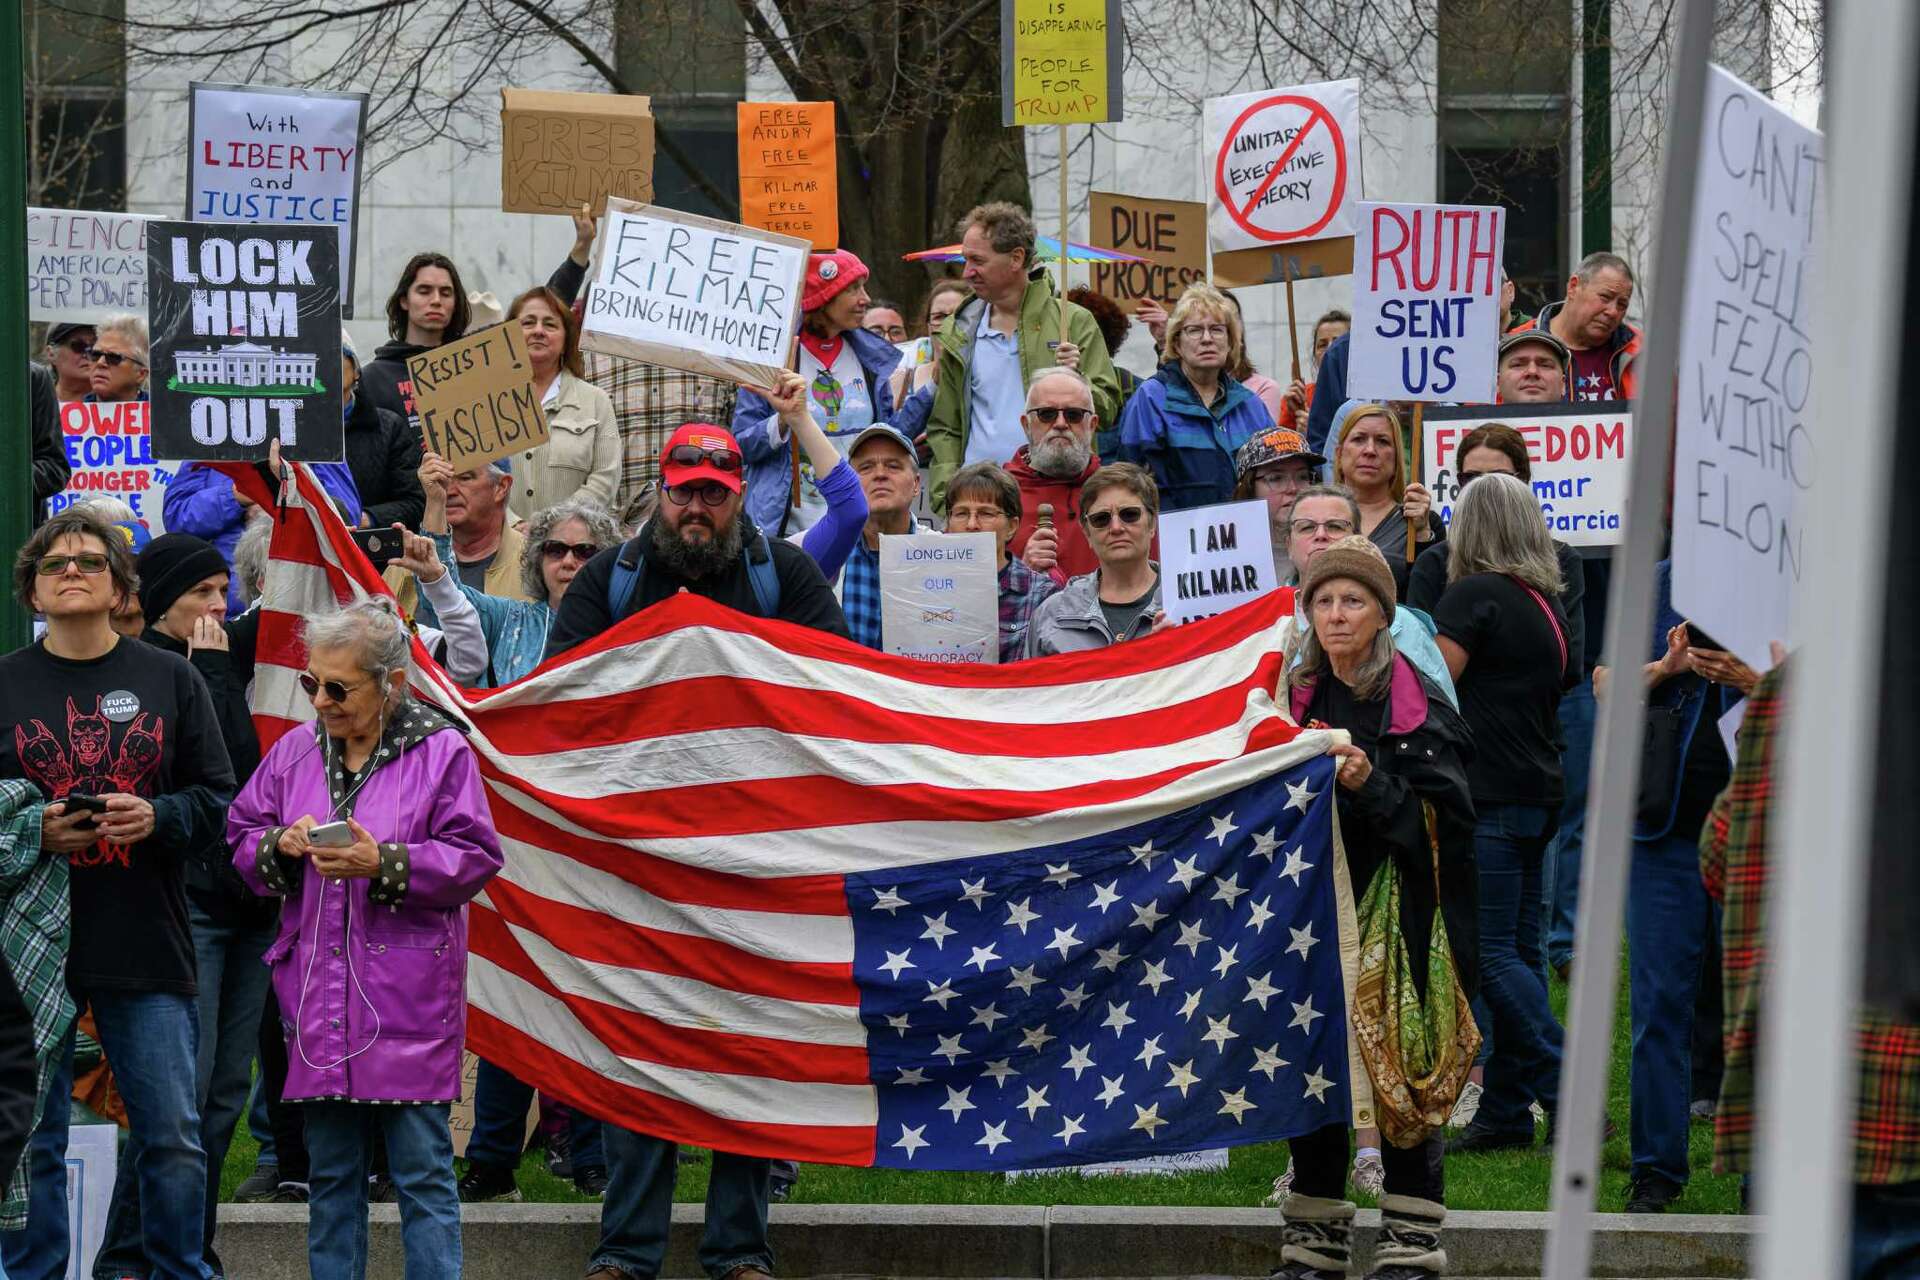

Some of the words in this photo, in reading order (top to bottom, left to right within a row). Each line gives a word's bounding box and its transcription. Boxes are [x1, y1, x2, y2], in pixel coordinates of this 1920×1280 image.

[1018, 19, 1107, 36] DISAPPEARING
[1020, 57, 1095, 78] PEOPLE
[1041, 79, 1085, 94] FOR
[759, 109, 810, 124] FREE
[1014, 94, 1099, 117] TRUMP
[246, 112, 299, 133] With
[752, 125, 813, 141] ANDRY
[204, 140, 355, 172] LIBERTY
[511, 114, 642, 167] FREE
[1232, 126, 1305, 154] UNITARY
[762, 150, 809, 164] FREE
[1229, 150, 1325, 188] EXECUTIVE
[1717, 92, 1827, 244] CAN'T
[250, 172, 294, 190] and
[508, 158, 653, 210] KILMAR
[764, 180, 818, 194] KILMAR
[1244, 177, 1313, 210] THEORY
[198, 189, 348, 223] JUSTICE
[768, 201, 807, 212] FREE
[1111, 205, 1177, 253] DUE
[36, 254, 145, 276] AMERICA'S
[170, 236, 316, 286] LOCK
[616, 218, 779, 283] FREE
[1369, 206, 1499, 297] RUTH
[610, 254, 786, 320] KILMAR
[1714, 210, 1812, 345] SPELL
[190, 288, 299, 338] HIM
[590, 286, 664, 323] BRING
[667, 303, 709, 337] HIM
[710, 315, 783, 355] HOME!
[1374, 296, 1475, 339] SENT
[1401, 345, 1458, 395] US
[190, 396, 304, 447] OUT
[423, 382, 544, 461] FASCISM
[1435, 421, 1625, 467] FEDOM
[65, 469, 151, 491] ONGER
[1697, 459, 1803, 584] ELON
[905, 548, 943, 561] LONG
[946, 548, 974, 561] LIVE
[1189, 527, 1197, 555] I
[1206, 522, 1238, 553] AM
[924, 578, 954, 590] OUR
[1176, 564, 1260, 601] KILMAR
[103, 704, 139, 716] TRUMP
[106, 696, 134, 707] FUCK
